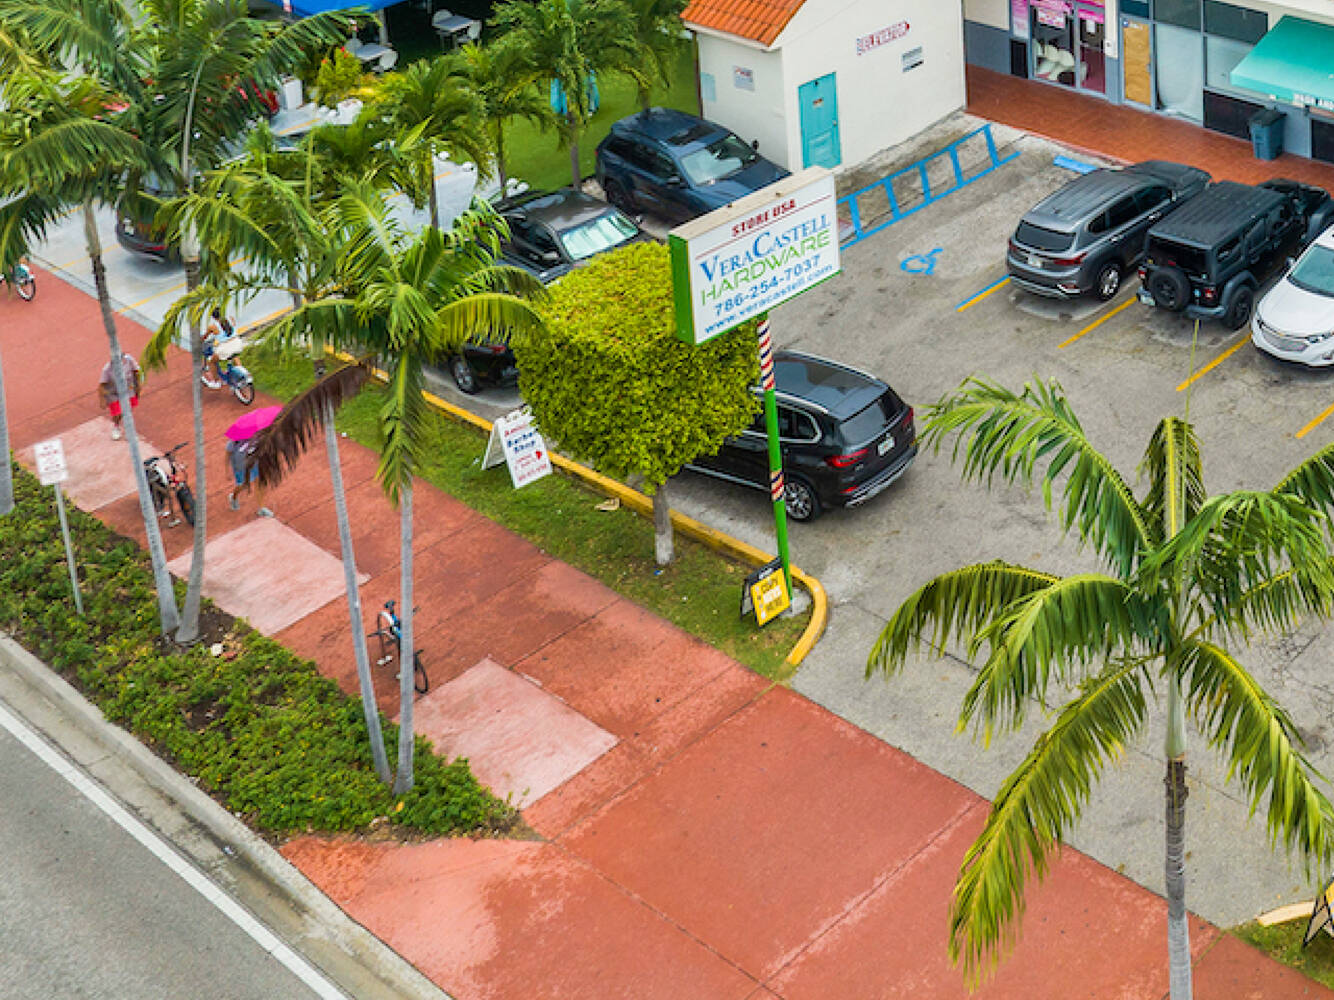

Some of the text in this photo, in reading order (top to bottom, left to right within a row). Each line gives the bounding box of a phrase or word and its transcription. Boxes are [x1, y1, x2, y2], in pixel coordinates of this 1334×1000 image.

[731, 199, 796, 237] STORE USA
[702, 229, 831, 306] HARDWARE
[714, 254, 821, 316] 786-254-7037
